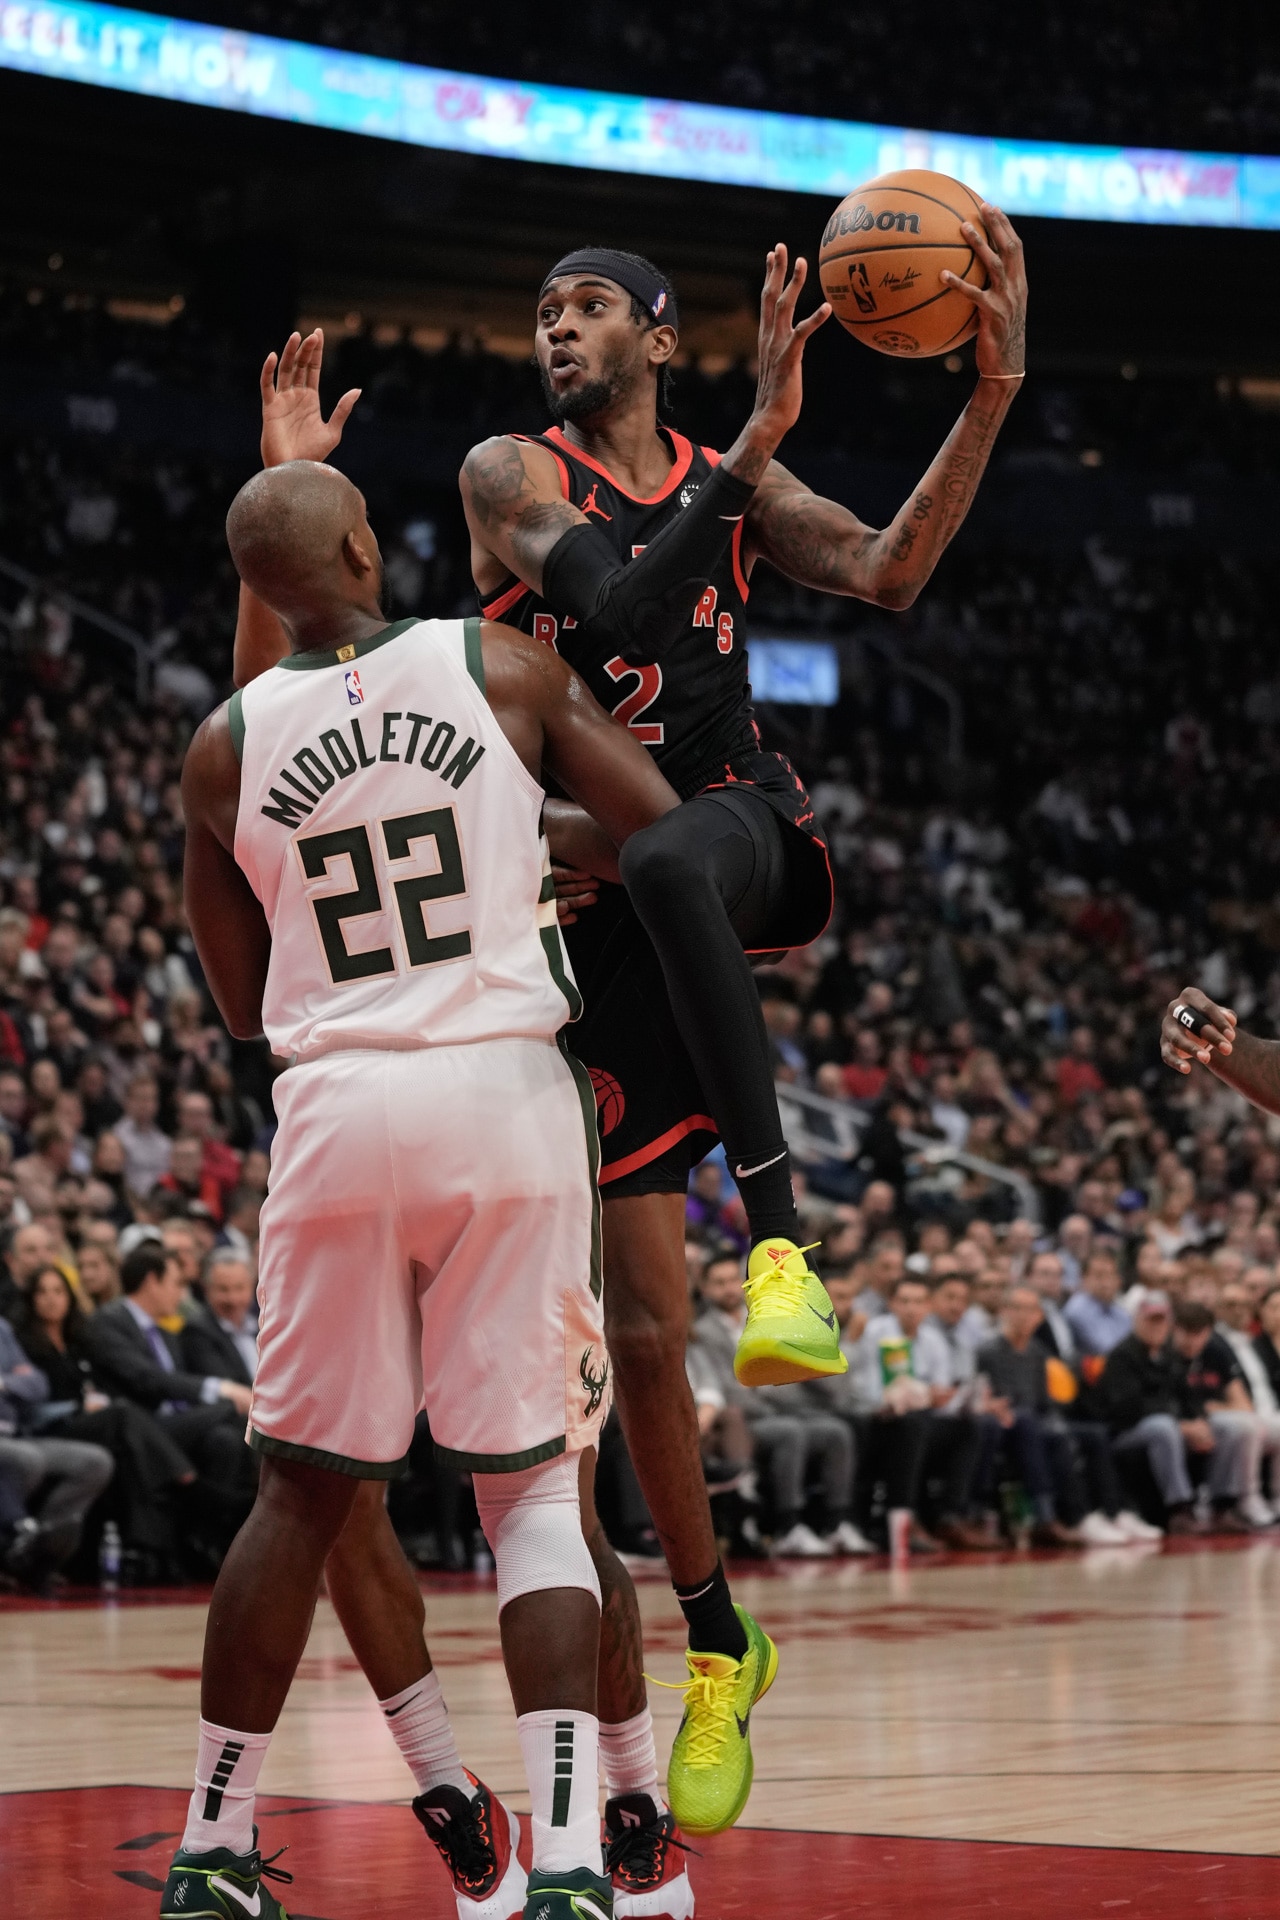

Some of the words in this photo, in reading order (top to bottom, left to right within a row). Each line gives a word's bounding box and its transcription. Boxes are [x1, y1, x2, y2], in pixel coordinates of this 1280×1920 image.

[101, 22, 142, 74] IT
[158, 35, 276, 98] NOW
[602, 654, 664, 745] 2
[260, 711, 486, 829] MIDDLETON
[291, 801, 475, 989] 22
